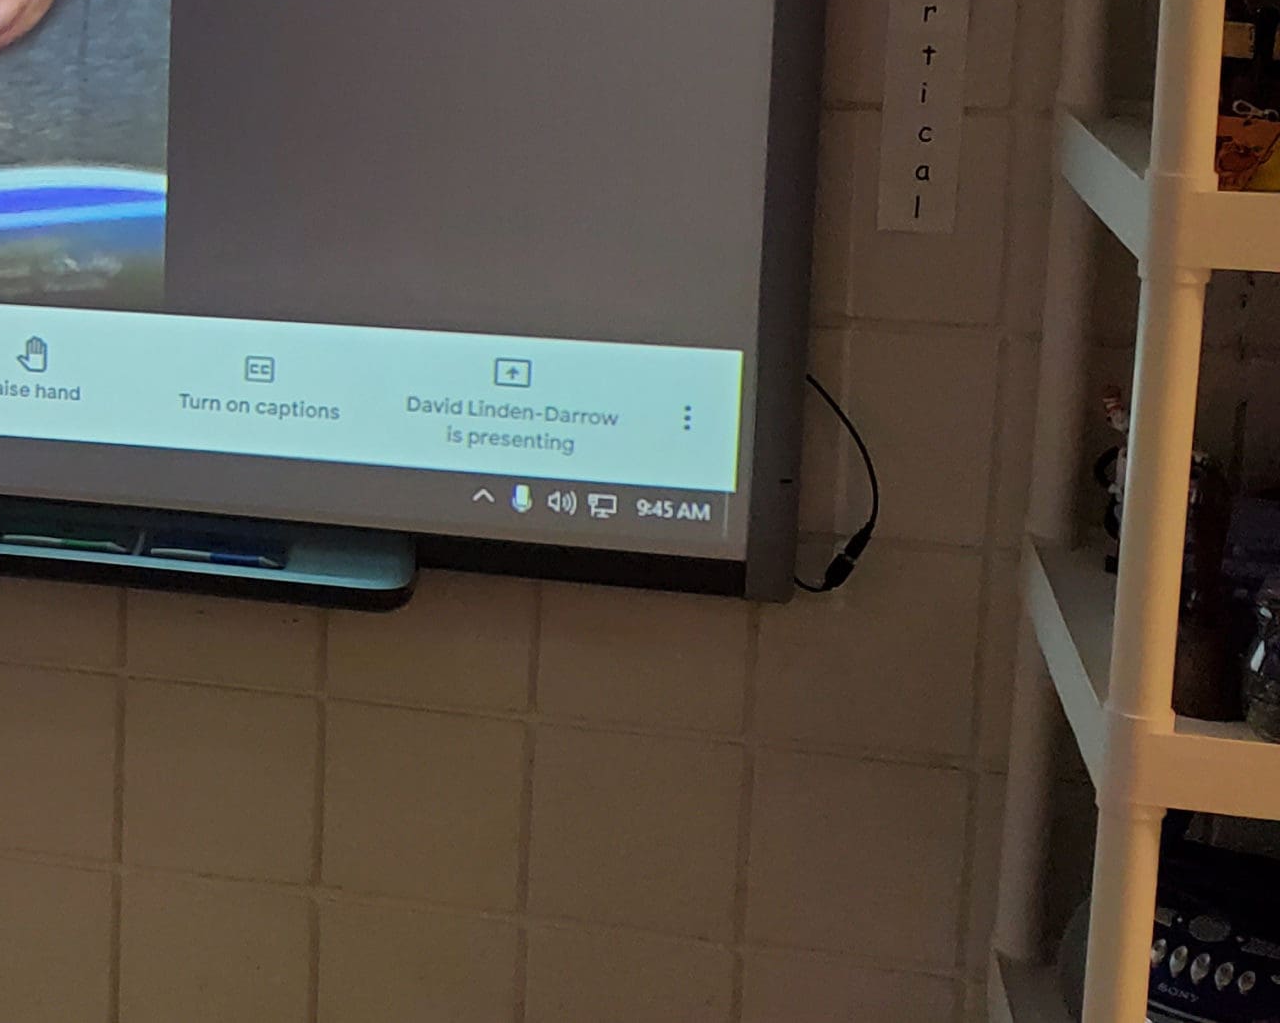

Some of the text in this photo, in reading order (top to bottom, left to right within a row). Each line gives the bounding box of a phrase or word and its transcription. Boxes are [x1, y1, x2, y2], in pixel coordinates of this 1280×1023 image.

[35, 382, 81, 401] hand
[179, 393, 340, 421] Turn on captions
[406, 395, 619, 428] David Linden-Darrow
[446, 425, 575, 456] is presenting
[636, 498, 712, 521] 9:45 AM
[1157, 982, 1199, 1003] SONY
